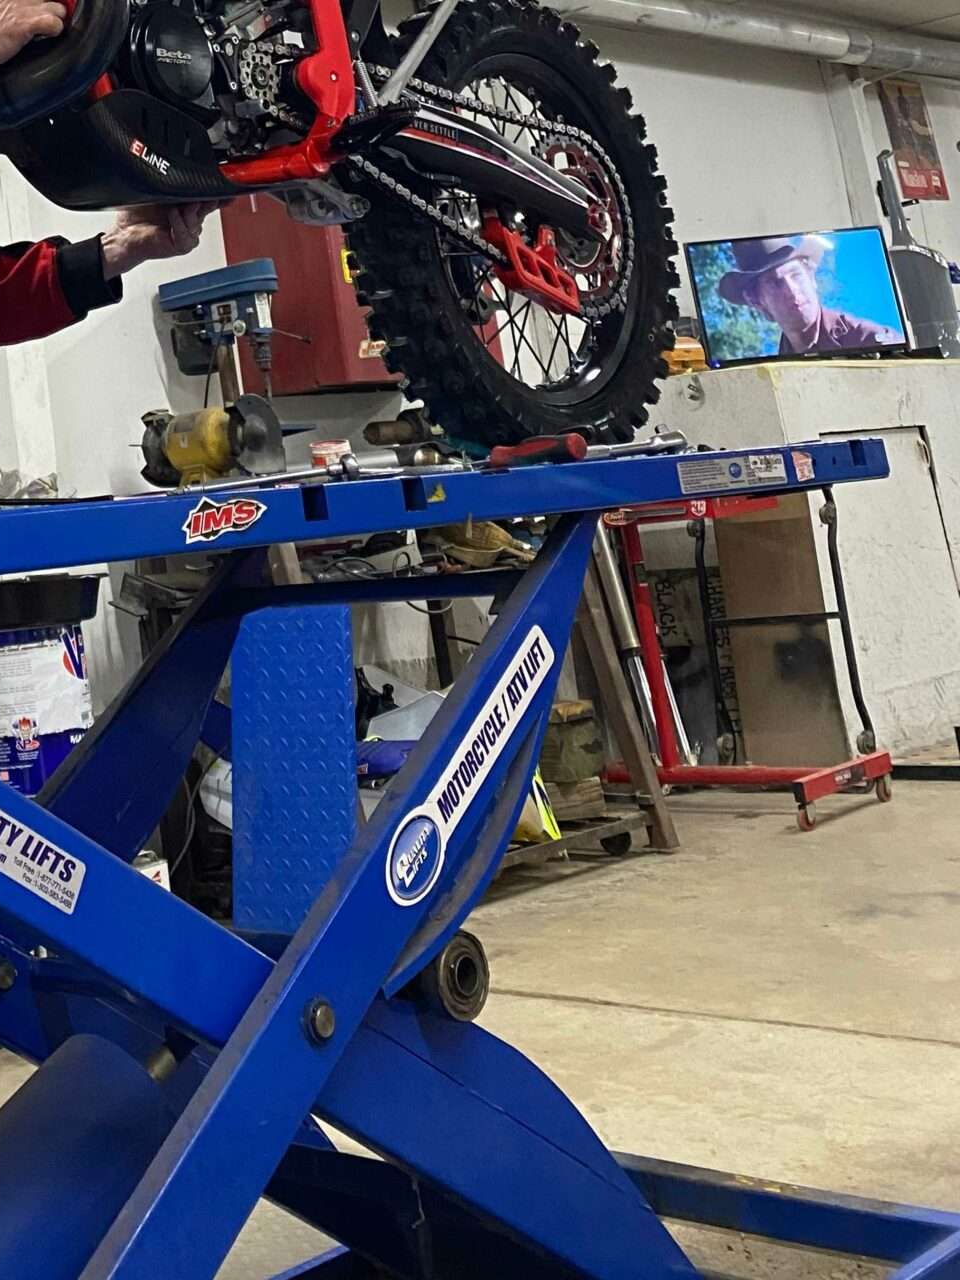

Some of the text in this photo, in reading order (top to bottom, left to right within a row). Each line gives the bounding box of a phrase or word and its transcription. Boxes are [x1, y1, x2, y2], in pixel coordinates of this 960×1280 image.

[156, 48, 191, 60] Beta
[191, 501, 257, 537] IMS
[656, 580, 677, 637] BLACK
[436, 704, 506, 824] MOTORCYCLE
[505, 664, 531, 712] ATV
[524, 637, 547, 686] LIFT
[20, 835, 77, 883] LIFTS
